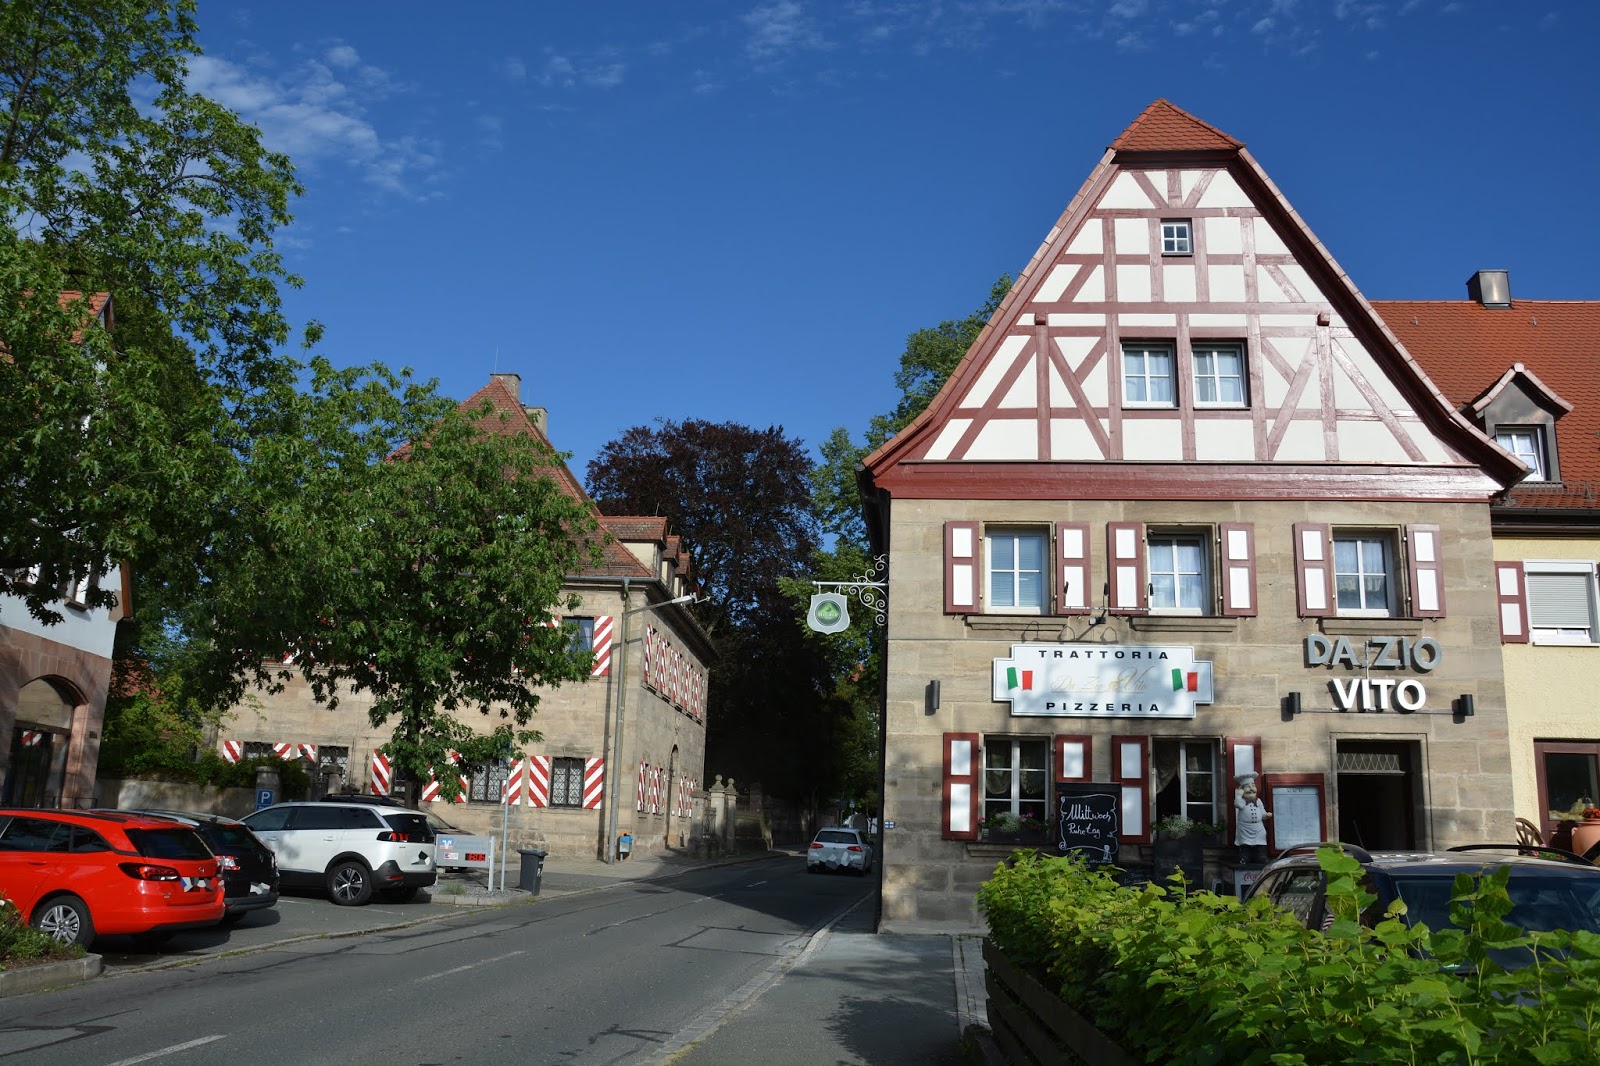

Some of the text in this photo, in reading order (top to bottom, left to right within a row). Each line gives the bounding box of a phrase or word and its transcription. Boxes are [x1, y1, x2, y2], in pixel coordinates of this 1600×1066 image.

[1038, 650, 1168, 660] TRATTORIA
[1370, 635, 1443, 671] ZIO
[1332, 678, 1427, 711] VITO
[1046, 702, 1159, 712] PIZZERIA
[260, 791, 271, 804] P
[1066, 803, 1112, 822] Mittwoch
